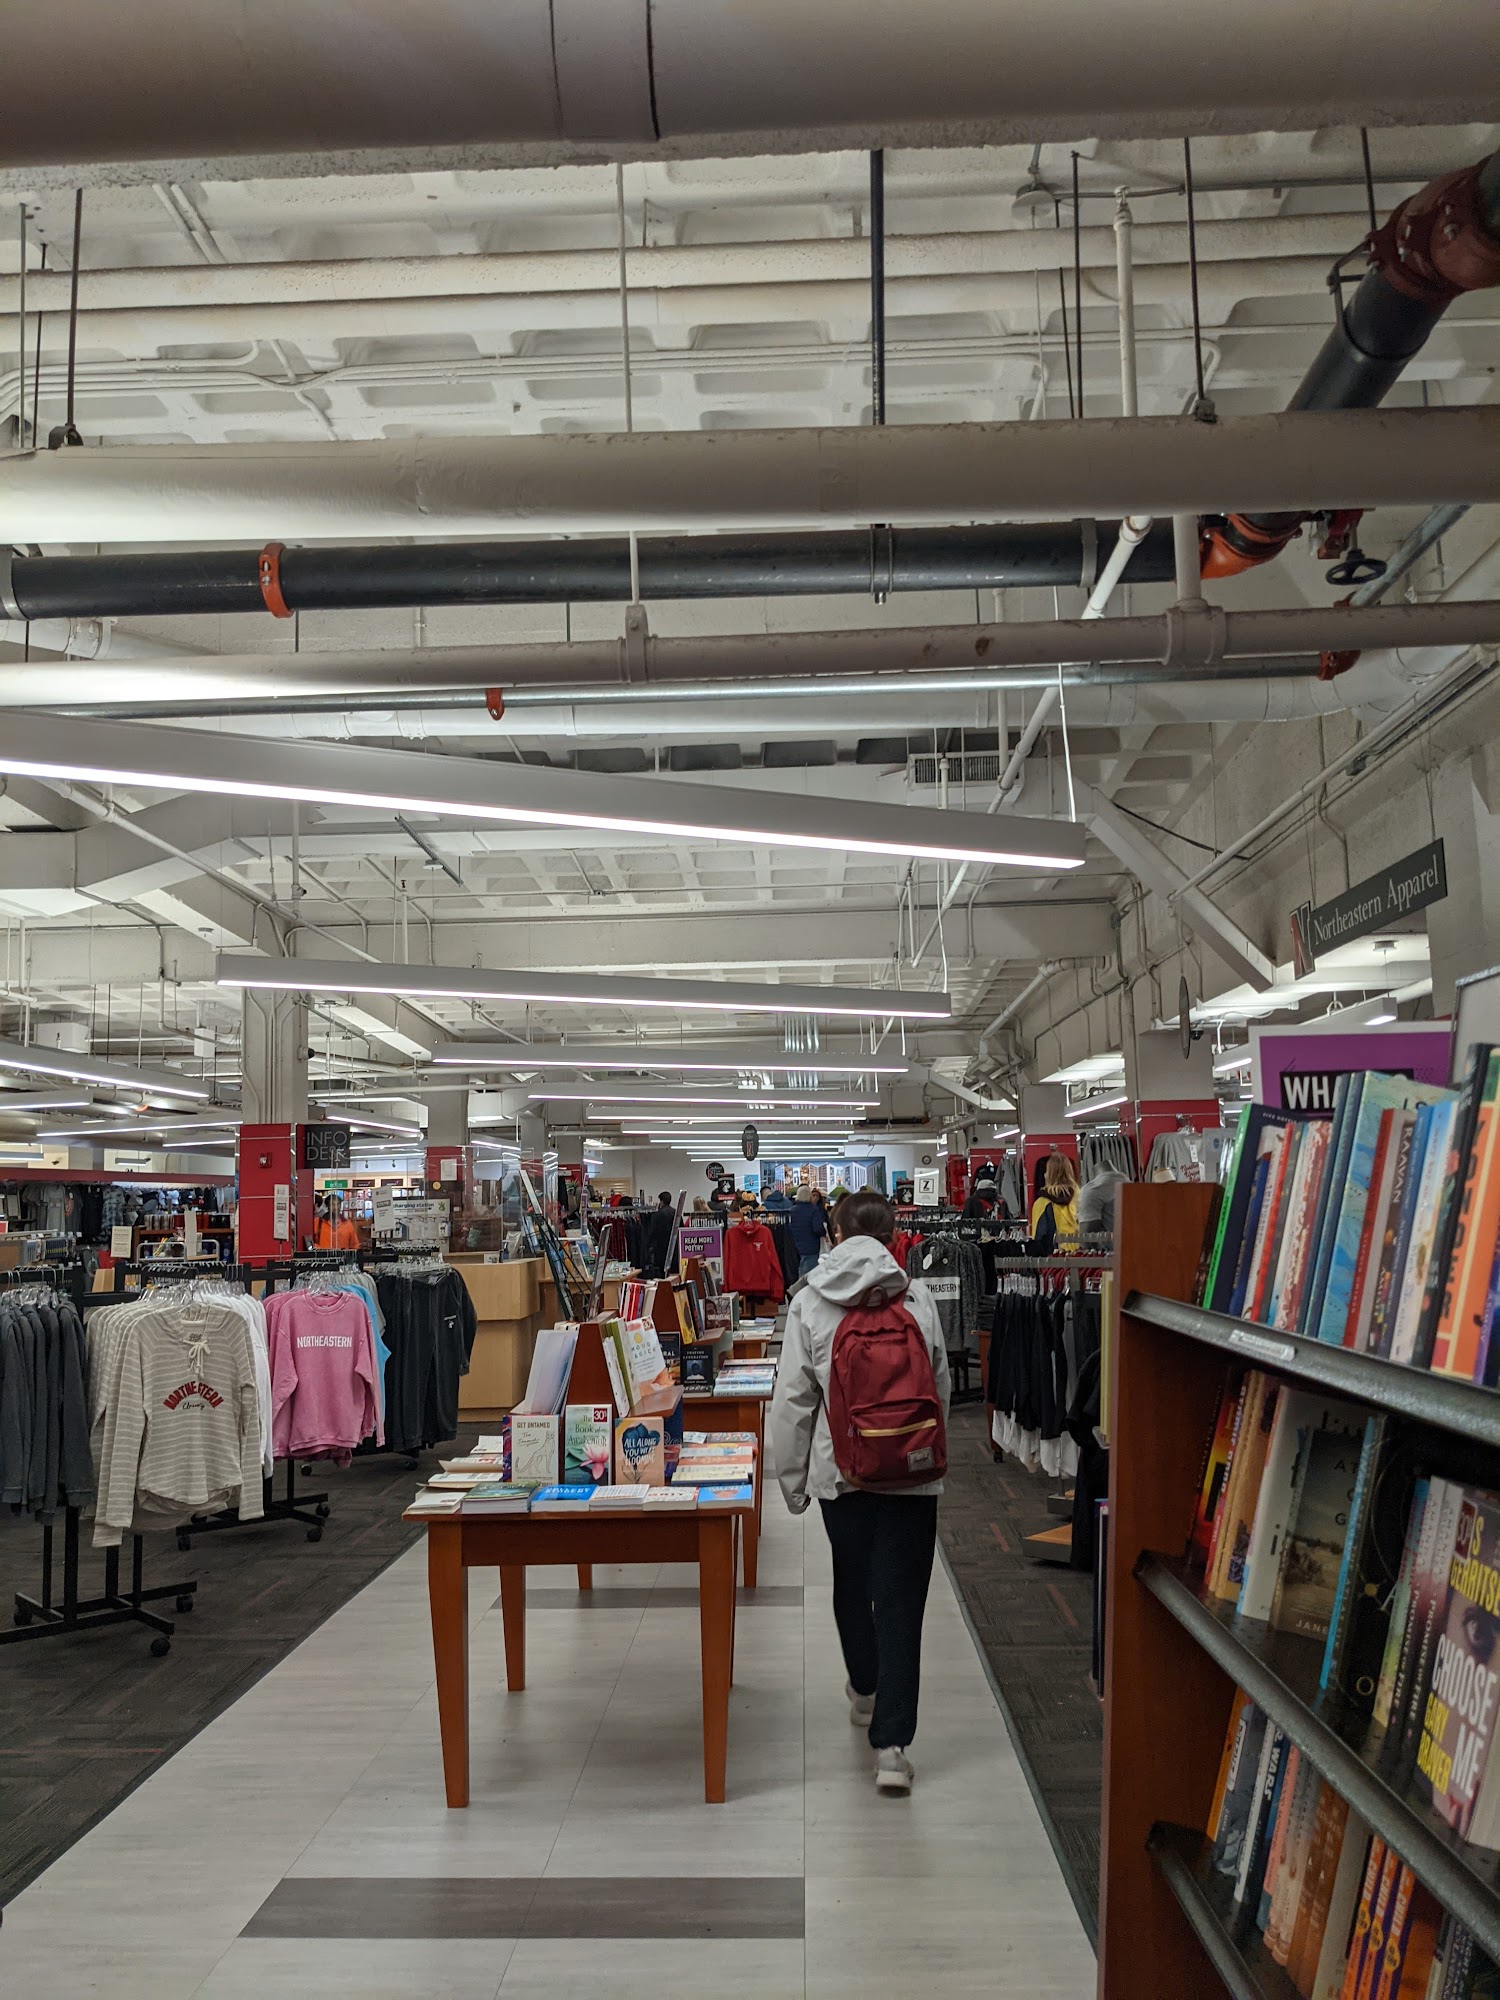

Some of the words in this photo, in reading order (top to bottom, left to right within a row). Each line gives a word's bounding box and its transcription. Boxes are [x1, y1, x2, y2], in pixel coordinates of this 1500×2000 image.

[1314, 895, 1382, 945] Northeastern
[1387, 854, 1439, 912] Apparel
[307, 1131, 347, 1146] INFO
[306, 1146, 350, 1160] DESK
[1392, 1127, 1412, 1203] RAAVAN
[698, 1236, 713, 1244] MORE
[684, 1244, 704, 1252] POETRY
[296, 1335, 353, 1348] NORTHEASTERN
[516, 1421, 527, 1429] GET
[527, 1421, 551, 1429] UNTAMED
[575, 1423, 593, 1433] Book
[568, 1434, 607, 1447] Awakening
[624, 1438, 636, 1448] ALL
[636, 1437, 657, 1448] ALONG
[625, 1447, 640, 1460] YOU
[1432, 1633, 1498, 1735] CHOOSE
[1451, 1722, 1484, 1799] ME
[1264, 1747, 1281, 1801] WARS
